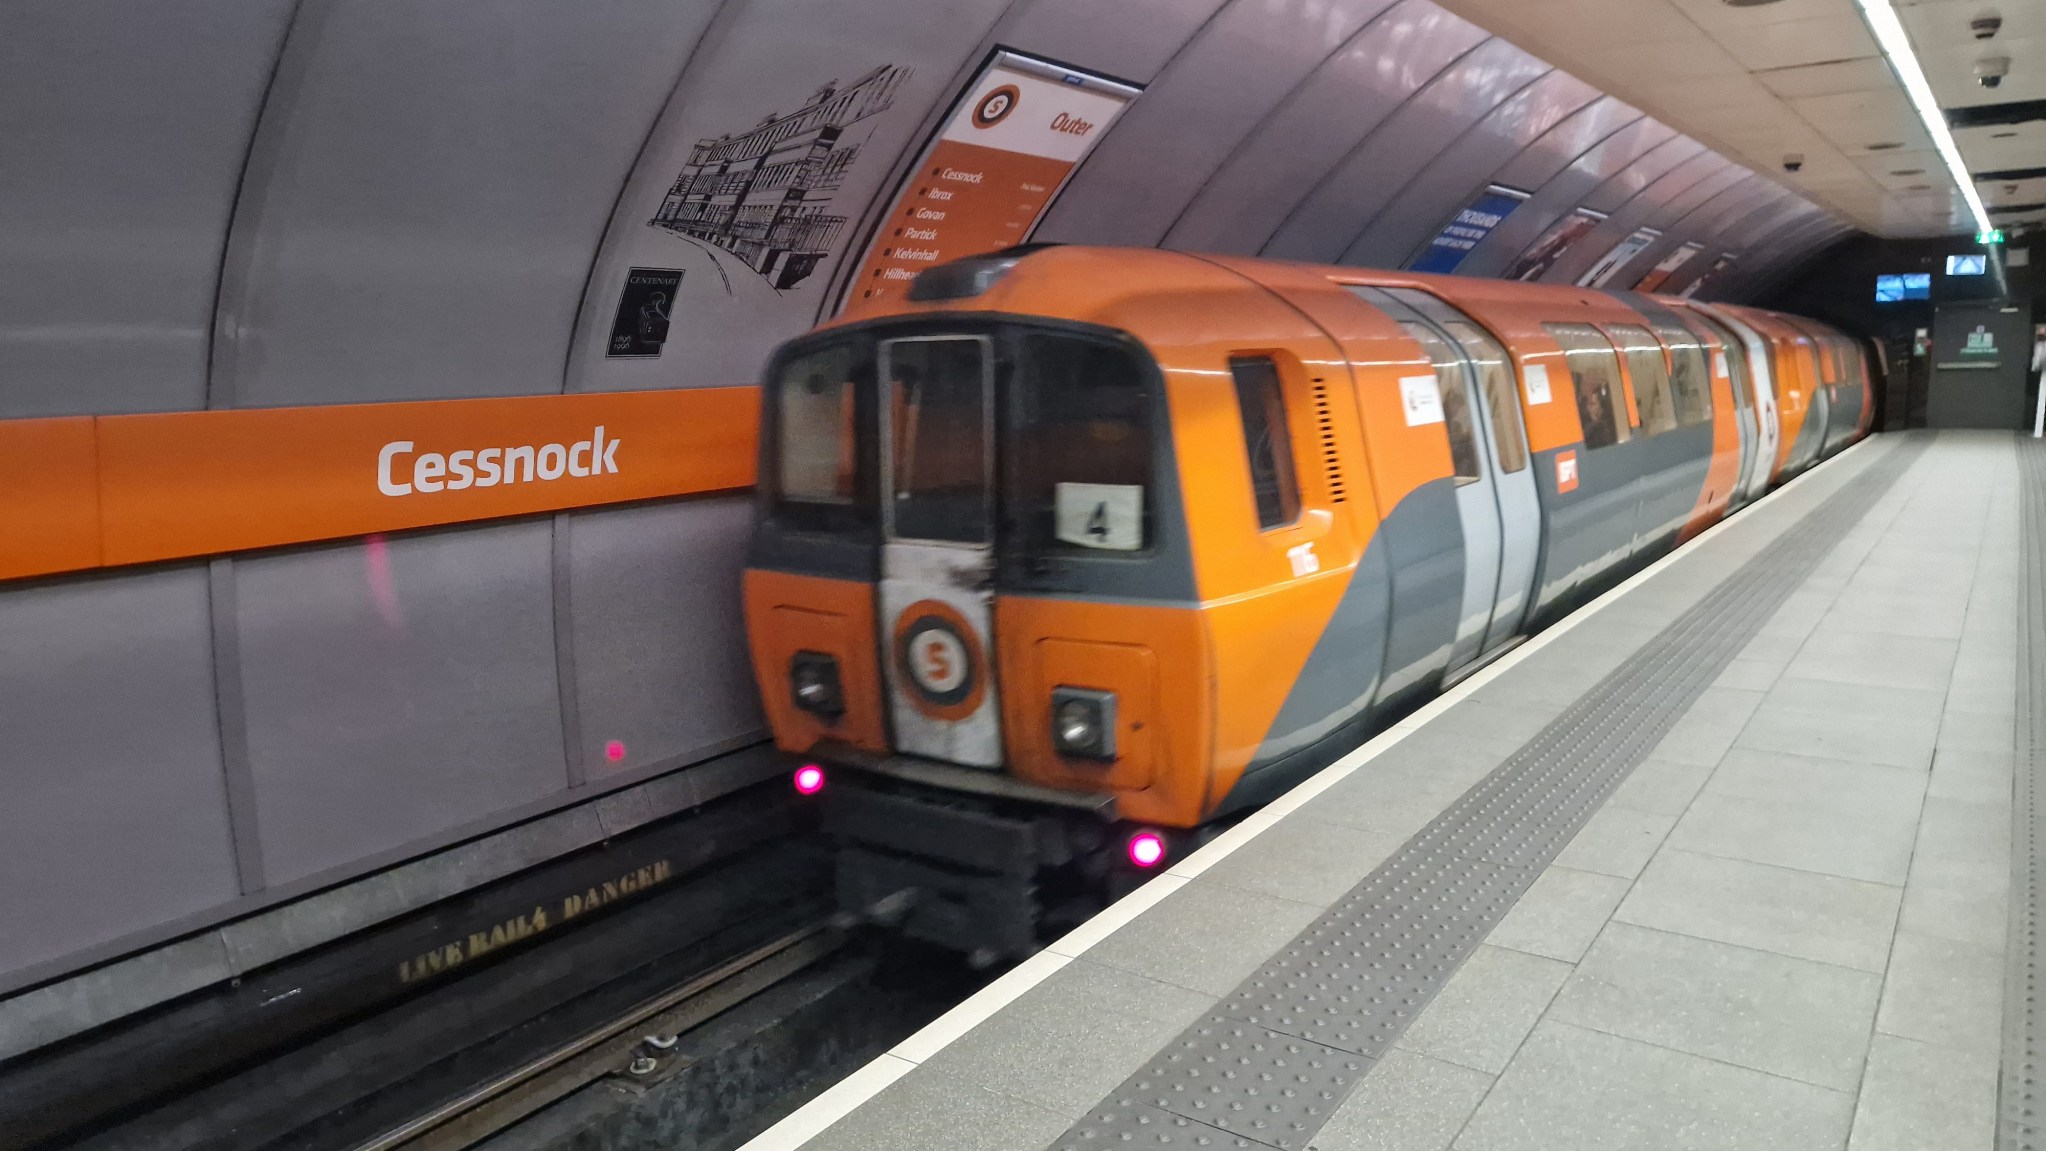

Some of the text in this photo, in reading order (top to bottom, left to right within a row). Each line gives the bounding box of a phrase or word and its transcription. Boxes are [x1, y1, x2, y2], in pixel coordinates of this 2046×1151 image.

[1049, 111, 1094, 137] Outer
[941, 167, 983, 184] Cessnock
[928, 187, 953, 202] Ibrox
[916, 207, 945, 222] Govan
[904, 227, 938, 242] Partick
[893, 247, 939, 262] Kelvinhall
[629, 276, 678, 285] CENTENARY
[377, 425, 621, 497] Cessnock
[1085, 501, 1112, 543] 4
[924, 642, 951, 680] S
[399, 940, 463, 984] LIVE
[563, 860, 672, 919] DANGER
